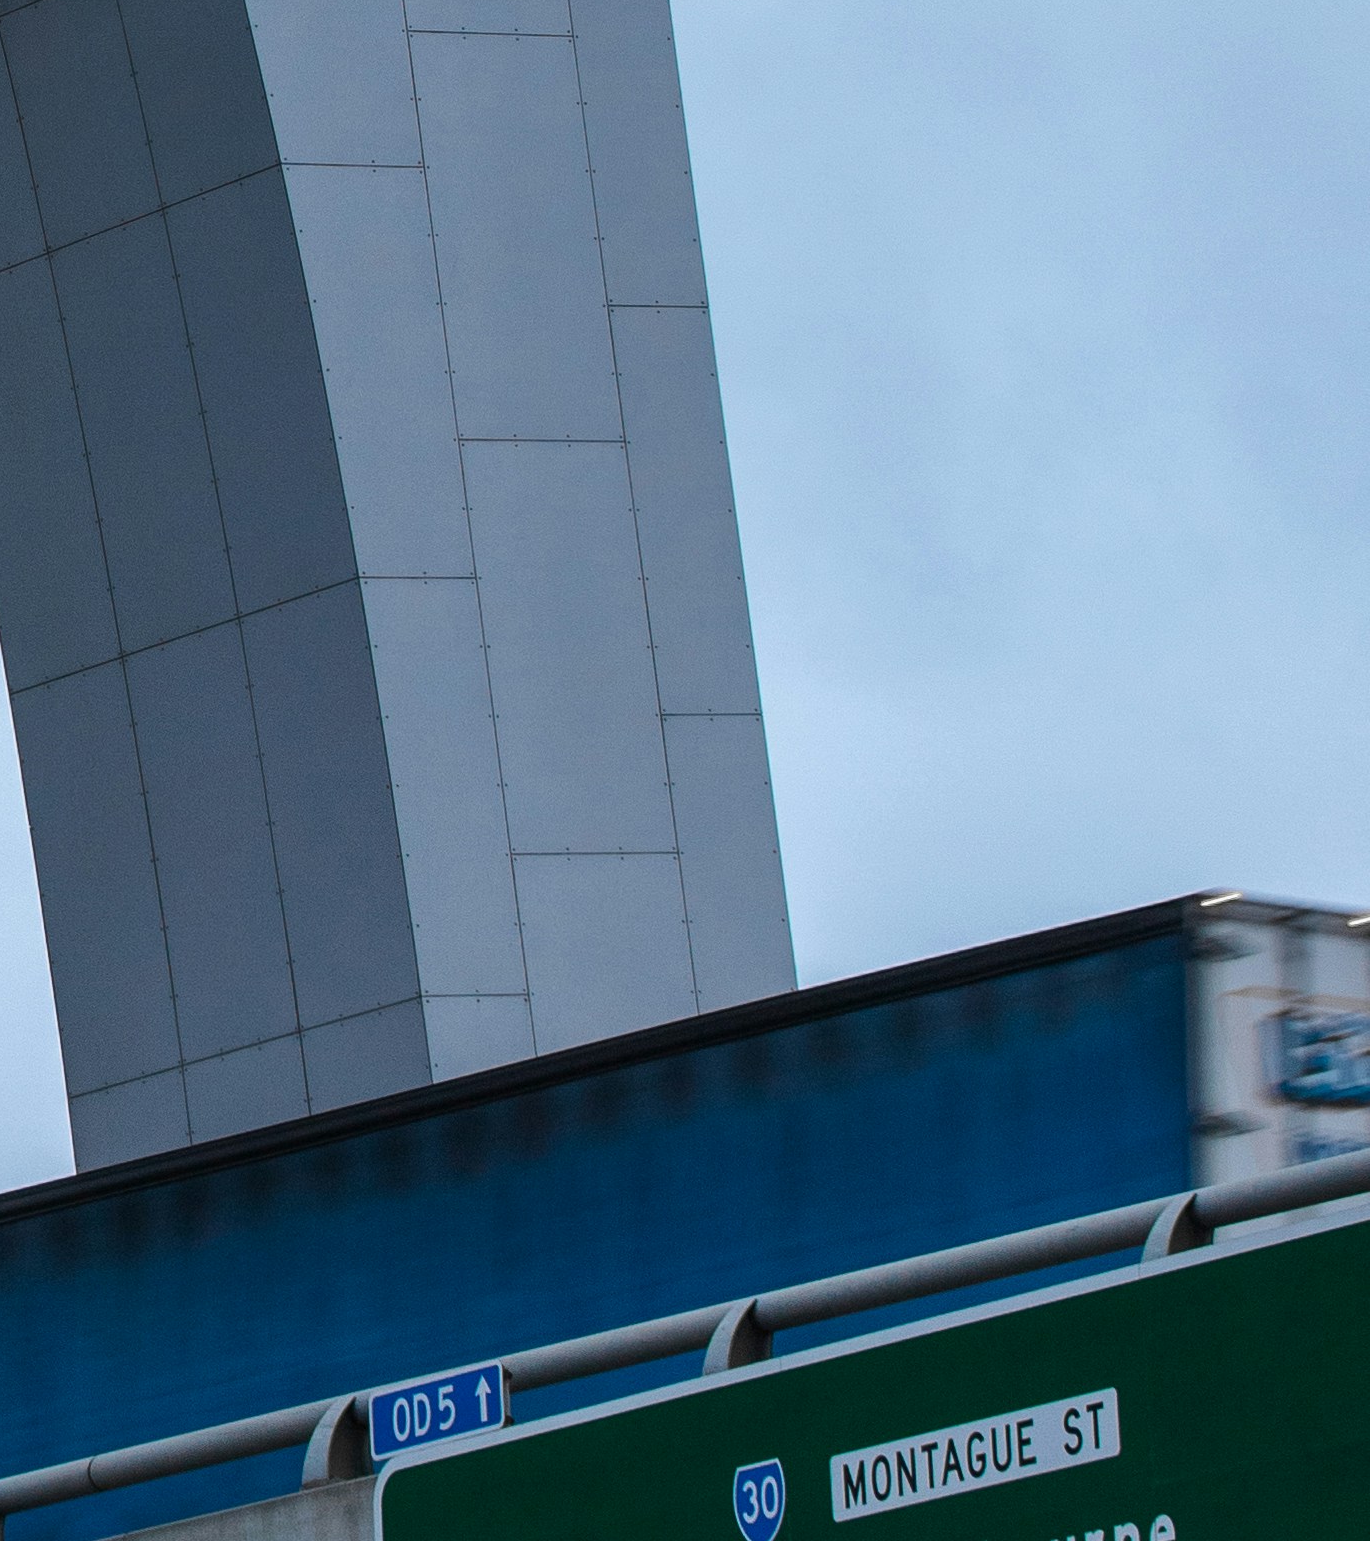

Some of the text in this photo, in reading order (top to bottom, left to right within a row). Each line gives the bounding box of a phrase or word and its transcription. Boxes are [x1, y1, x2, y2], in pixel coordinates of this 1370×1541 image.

[842, 1401, 1105, 1510] MONTAGUE ST
[742, 1475, 780, 1524] 30
